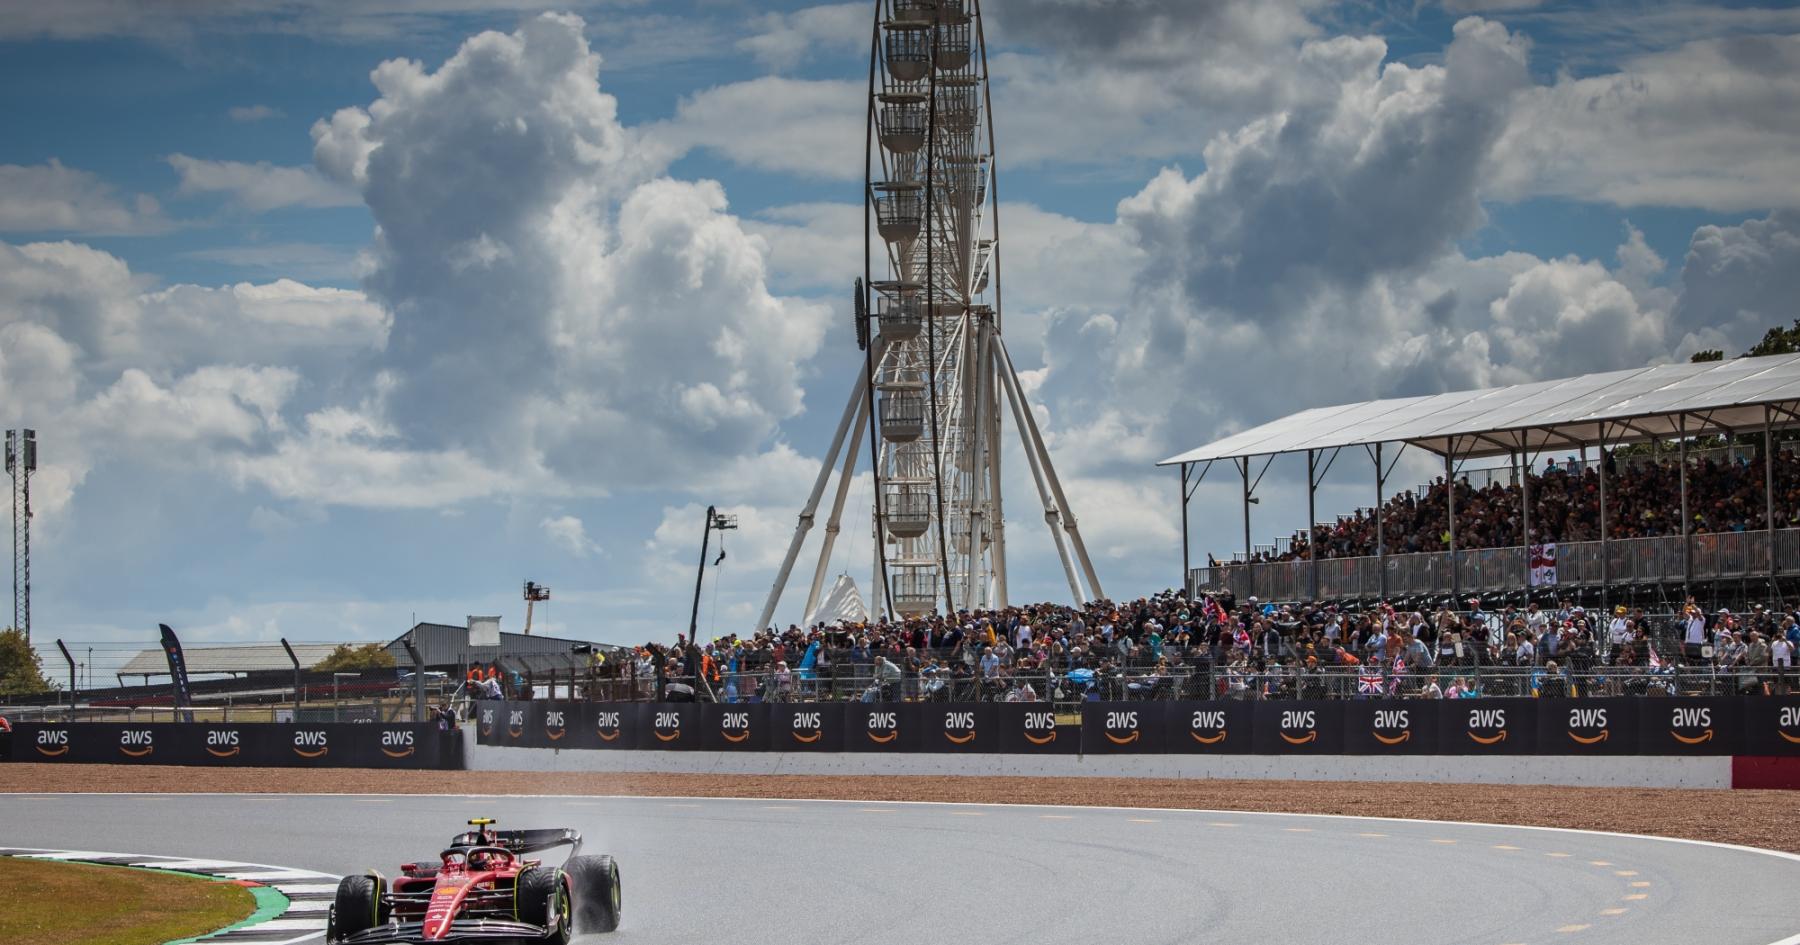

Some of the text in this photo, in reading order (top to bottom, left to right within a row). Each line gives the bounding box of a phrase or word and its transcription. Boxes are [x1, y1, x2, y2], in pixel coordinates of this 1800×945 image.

[510, 710, 523, 725] aws
[547, 712, 564, 726] aws
[599, 712, 619, 727] aws
[656, 712, 679, 727] aws
[723, 713, 748, 728] aws
[794, 713, 820, 728] aws
[869, 713, 896, 728] aws
[946, 712, 974, 728] aws
[1025, 712, 1055, 729] aws
[1107, 712, 1137, 728] aws
[1192, 711, 1225, 728] aws
[1282, 711, 1315, 728] aws
[1375, 710, 1408, 728] aws
[1469, 709, 1505, 727] aws
[1570, 709, 1606, 727] aws
[1673, 708, 1710, 727] aws
[1780, 707, 1800, 726] aw
[38, 731, 67, 744] aws
[121, 731, 152, 744] aws
[208, 731, 238, 744] aws
[295, 731, 326, 745] aws
[382, 731, 413, 745] aws
